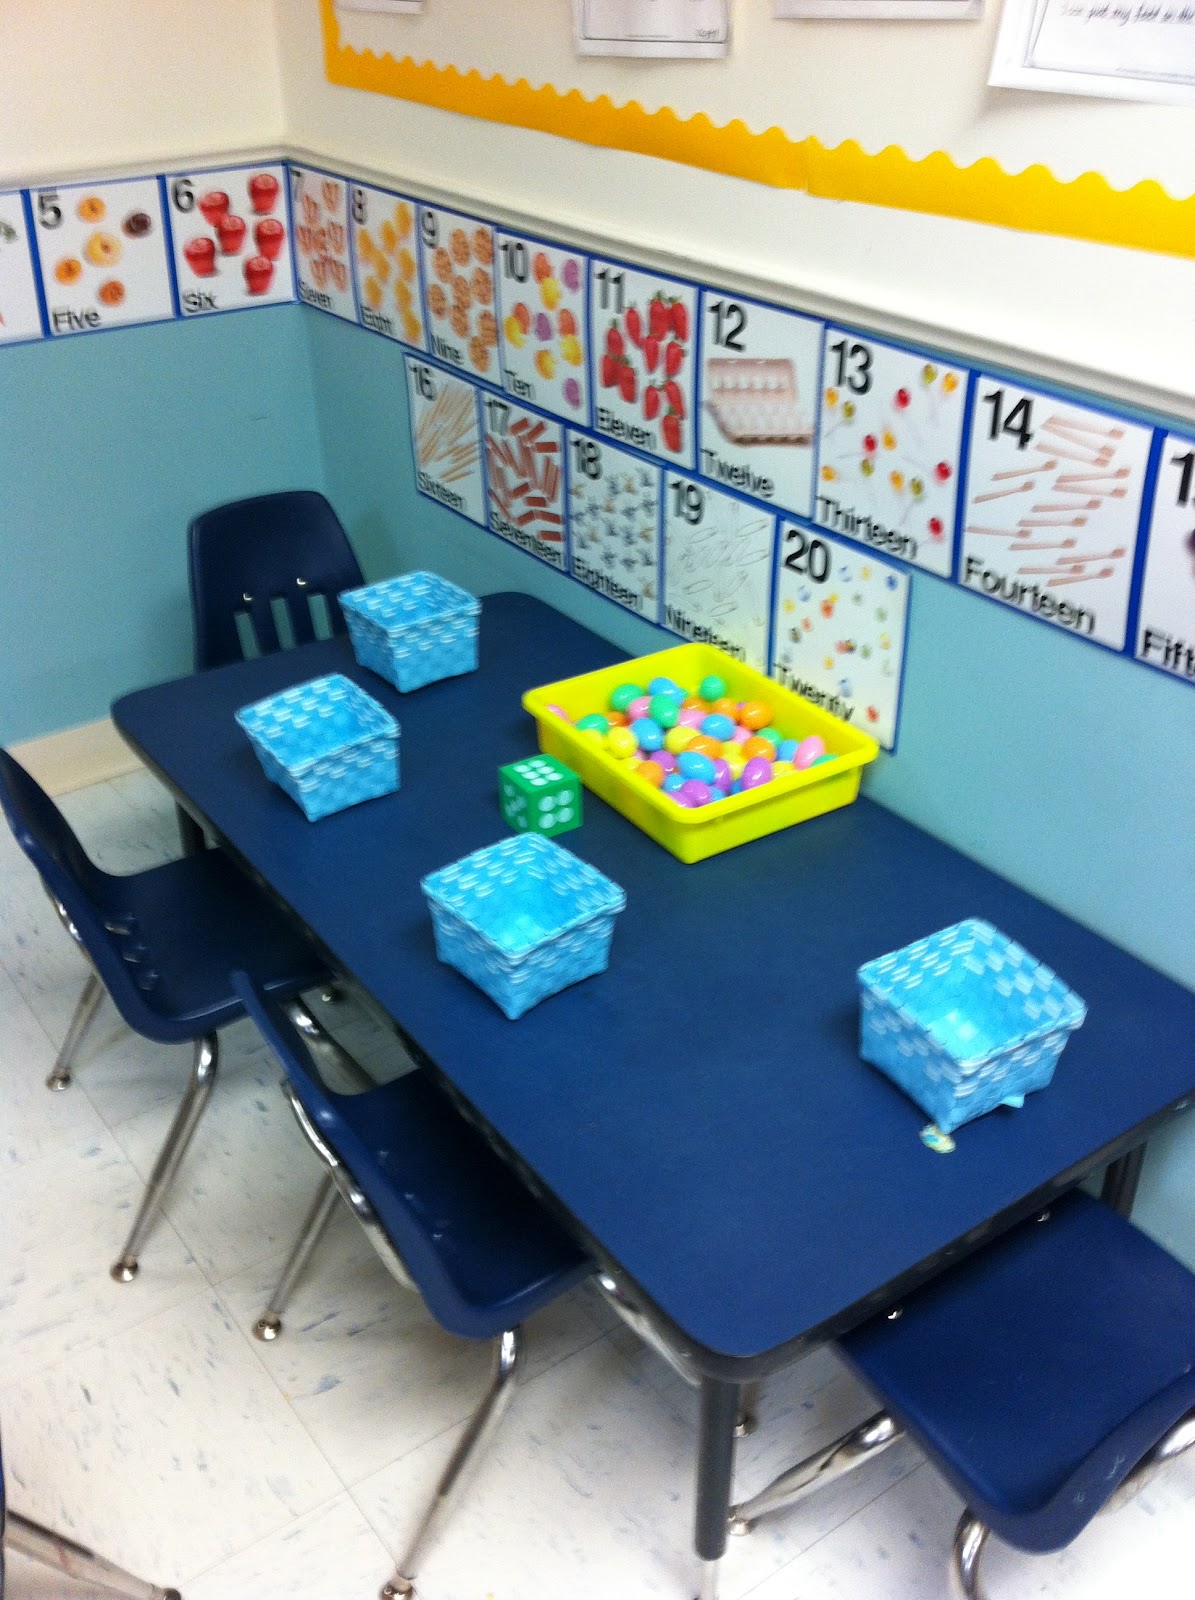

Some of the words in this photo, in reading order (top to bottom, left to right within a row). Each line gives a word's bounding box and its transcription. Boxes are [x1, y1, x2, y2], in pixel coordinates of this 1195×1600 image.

[38, 186, 63, 230] 5
[172, 178, 195, 213] 6
[351, 189, 367, 226] 8
[421, 211, 438, 249] 9
[500, 241, 529, 284] 10
[182, 290, 218, 314] Six
[596, 269, 625, 314] 11
[52, 305, 100, 333] Five
[708, 301, 747, 352] 12
[430, 333, 464, 365] Nine
[830, 340, 873, 395] 13
[409, 363, 436, 401] 16
[502, 368, 536, 401] Ten
[486, 399, 511, 437] 17
[596, 406, 657, 451] Eleven
[982, 389, 1034, 450] 14
[572, 437, 602, 481] 18
[701, 447, 775, 499] Twelve
[1170, 451, 1195, 508] 1
[418, 471, 467, 510] Sixteen
[670, 480, 704, 525] 19
[490, 512, 564, 564] Seventeen
[817, 496, 918, 560] Thirteen
[783, 529, 832, 584] 20
[572, 555, 643, 612] Eighteen
[964, 557, 1096, 635] Fourteen
